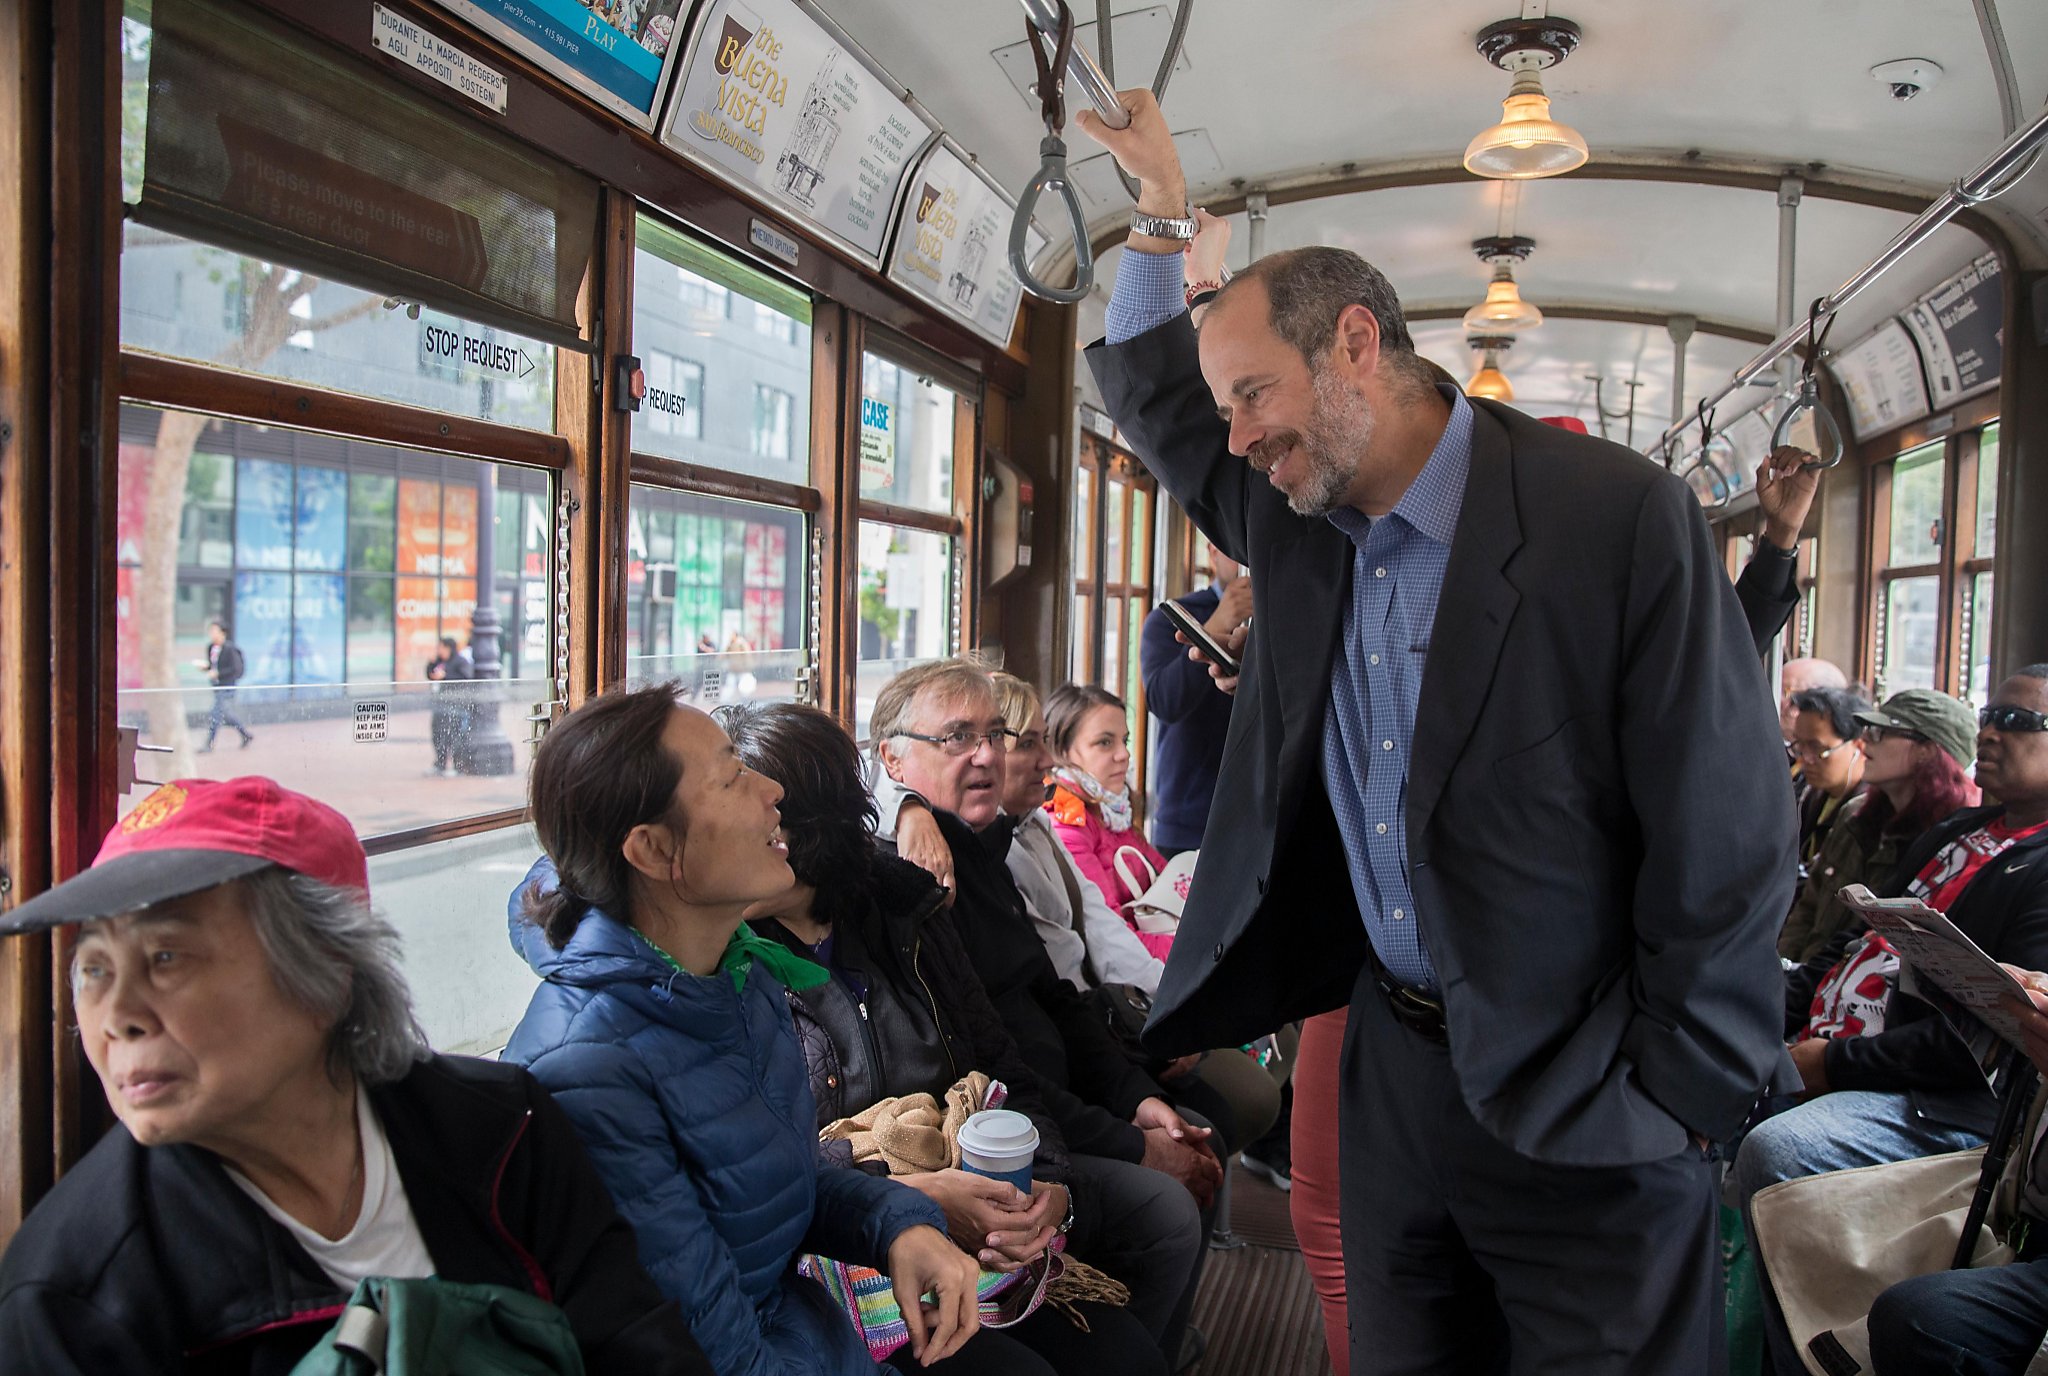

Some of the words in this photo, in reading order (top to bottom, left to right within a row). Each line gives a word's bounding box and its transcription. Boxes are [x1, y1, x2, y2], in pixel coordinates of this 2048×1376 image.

[503, 2, 536, 28] pier39.com
[544, 27, 580, 56] 415.981.PIER
[754, 26, 783, 62] the
[380, 12, 418, 44] DURANTE
[422, 35, 433, 52] LA
[437, 43, 465, 70] MARCIA
[468, 61, 502, 91] REGGERSI
[388, 37, 408, 57] AGLI
[416, 52, 452, 81] APPOSITI
[460, 75, 496, 105] SOSTEGNI
[243, 152, 310, 195] Please
[316, 183, 364, 216] move
[369, 203, 385, 222] to
[391, 209, 416, 233] the
[419, 224, 449, 248] rear
[287, 202, 325, 229] rear
[426, 325, 459, 357] STOP
[463, 336, 517, 373] REQUEST
[650, 387, 685, 417] REQUEST
[863, 398, 889, 431] CASE
[357, 704, 386, 712] CAUTION
[371, 713, 386, 721] HEAD
[355, 732, 373, 740] INSIDE
